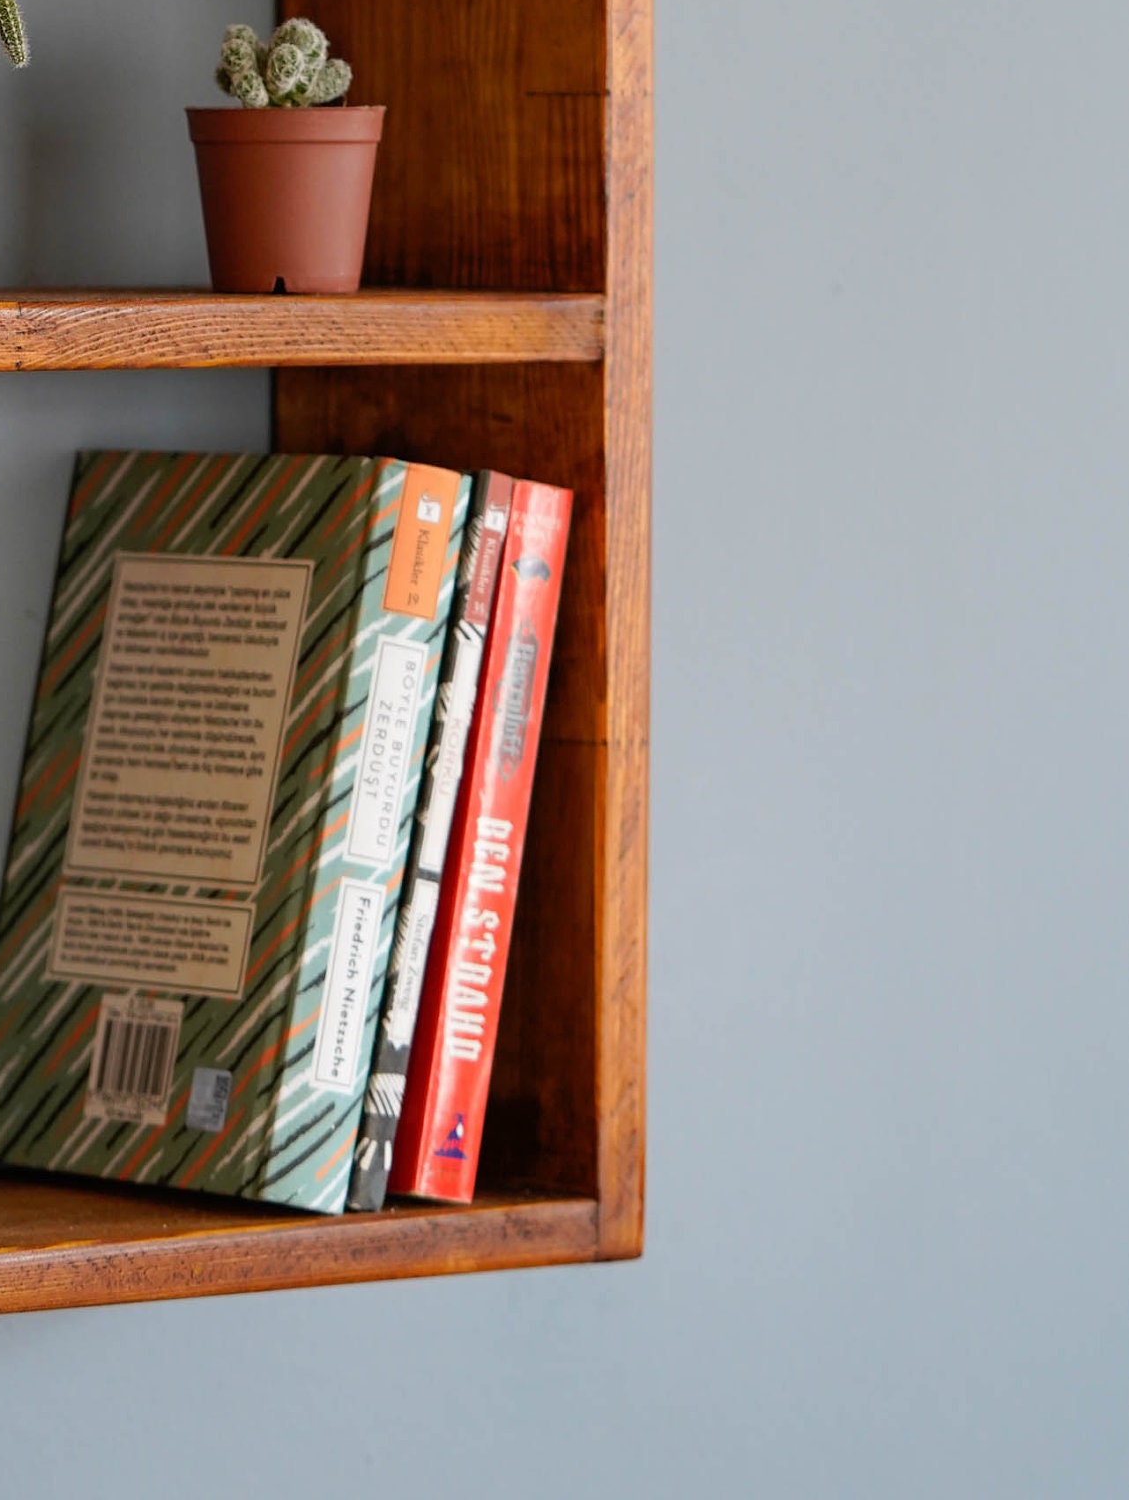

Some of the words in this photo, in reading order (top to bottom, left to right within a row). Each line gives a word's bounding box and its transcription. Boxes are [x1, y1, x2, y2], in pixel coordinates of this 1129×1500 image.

[410, 527, 431, 586] Klasikler
[376, 739, 403, 847] BUYURDU
[438, 716, 462, 796] KORKU
[346, 896, 372, 980] Friedrich
[409, 914, 429, 961] Stefan
[330, 986, 356, 1078] Nietzsche
